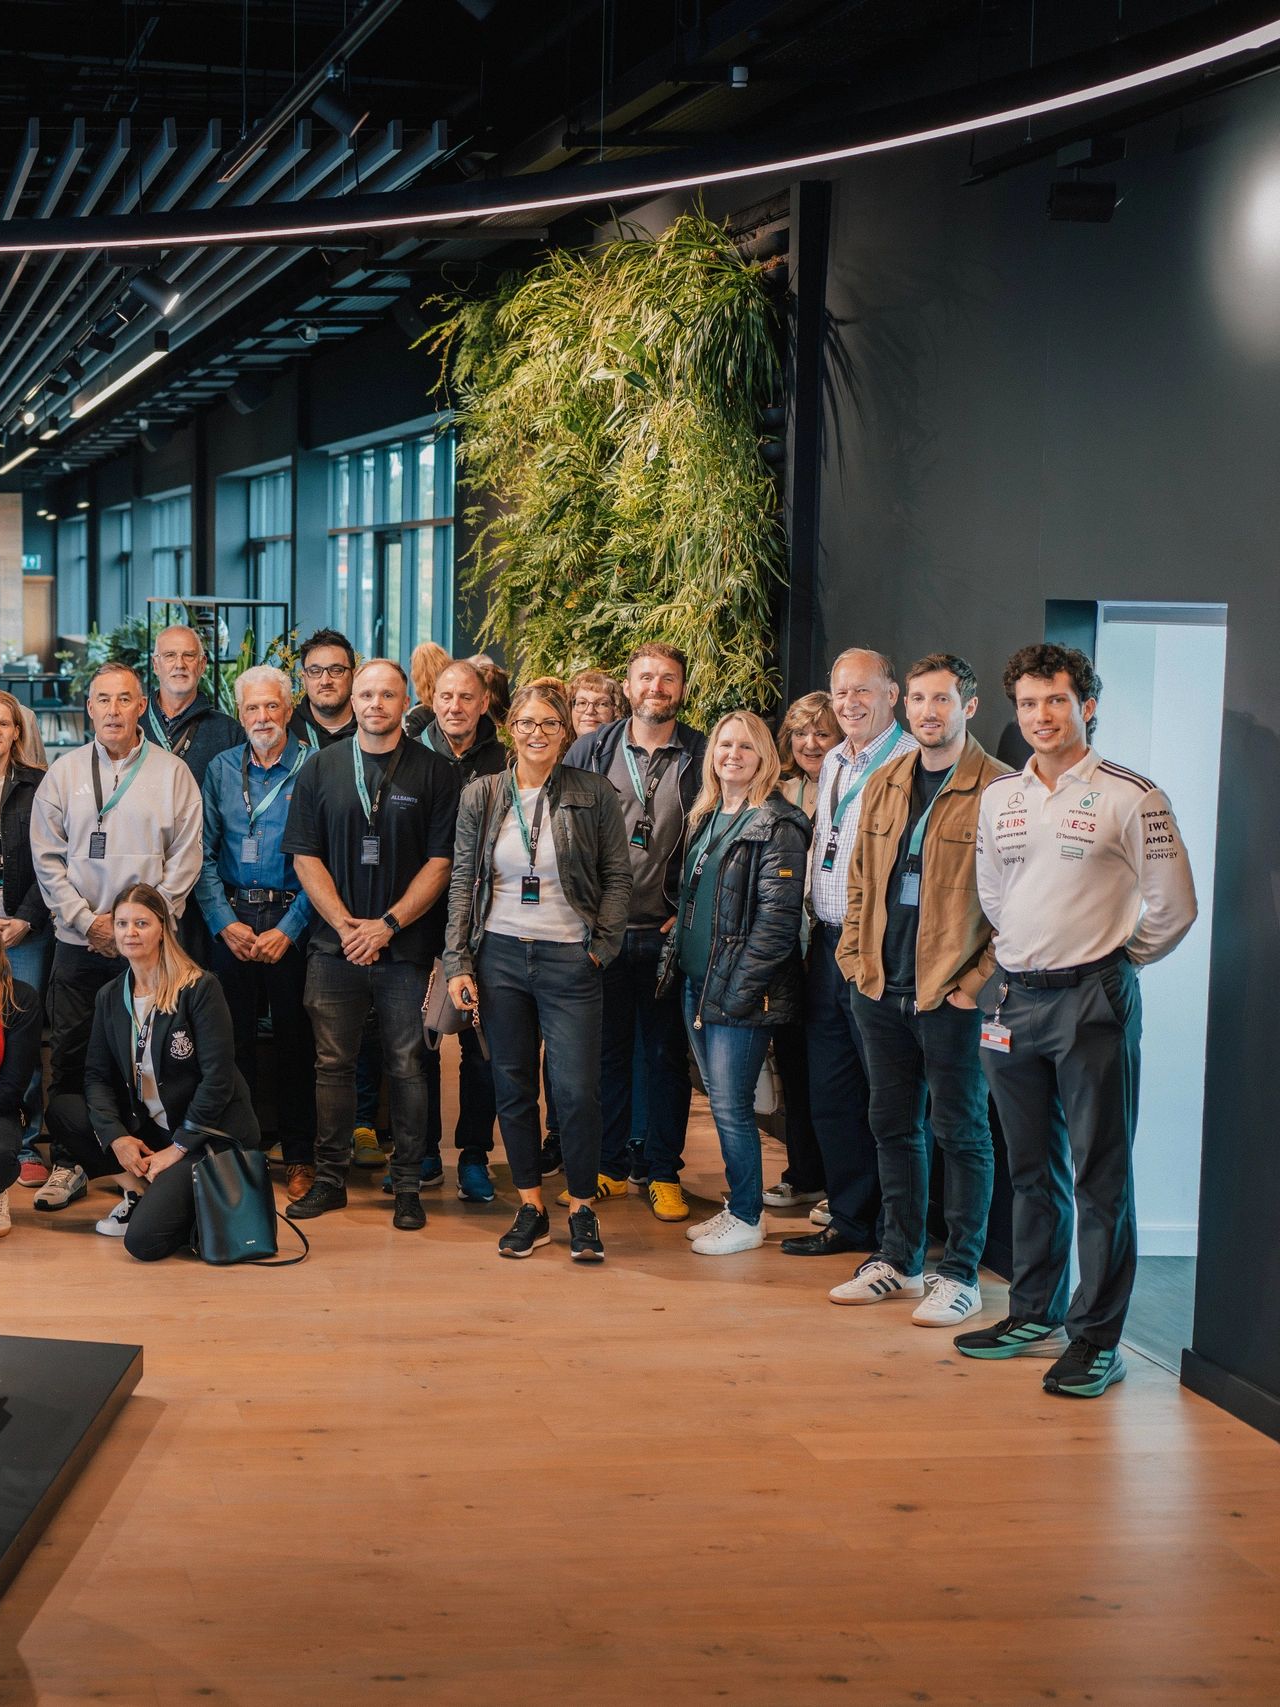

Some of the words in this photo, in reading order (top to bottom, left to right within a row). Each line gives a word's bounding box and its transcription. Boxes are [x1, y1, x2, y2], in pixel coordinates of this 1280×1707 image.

[1068, 809, 1097, 818] PETRONAS
[1005, 818, 1026, 829] UBS
[1060, 818, 1097, 833] INEOS
[1148, 820, 1169, 831] IWC
[1145, 835, 1170, 845] AMD
[1145, 851, 1178, 861] BONVOY
